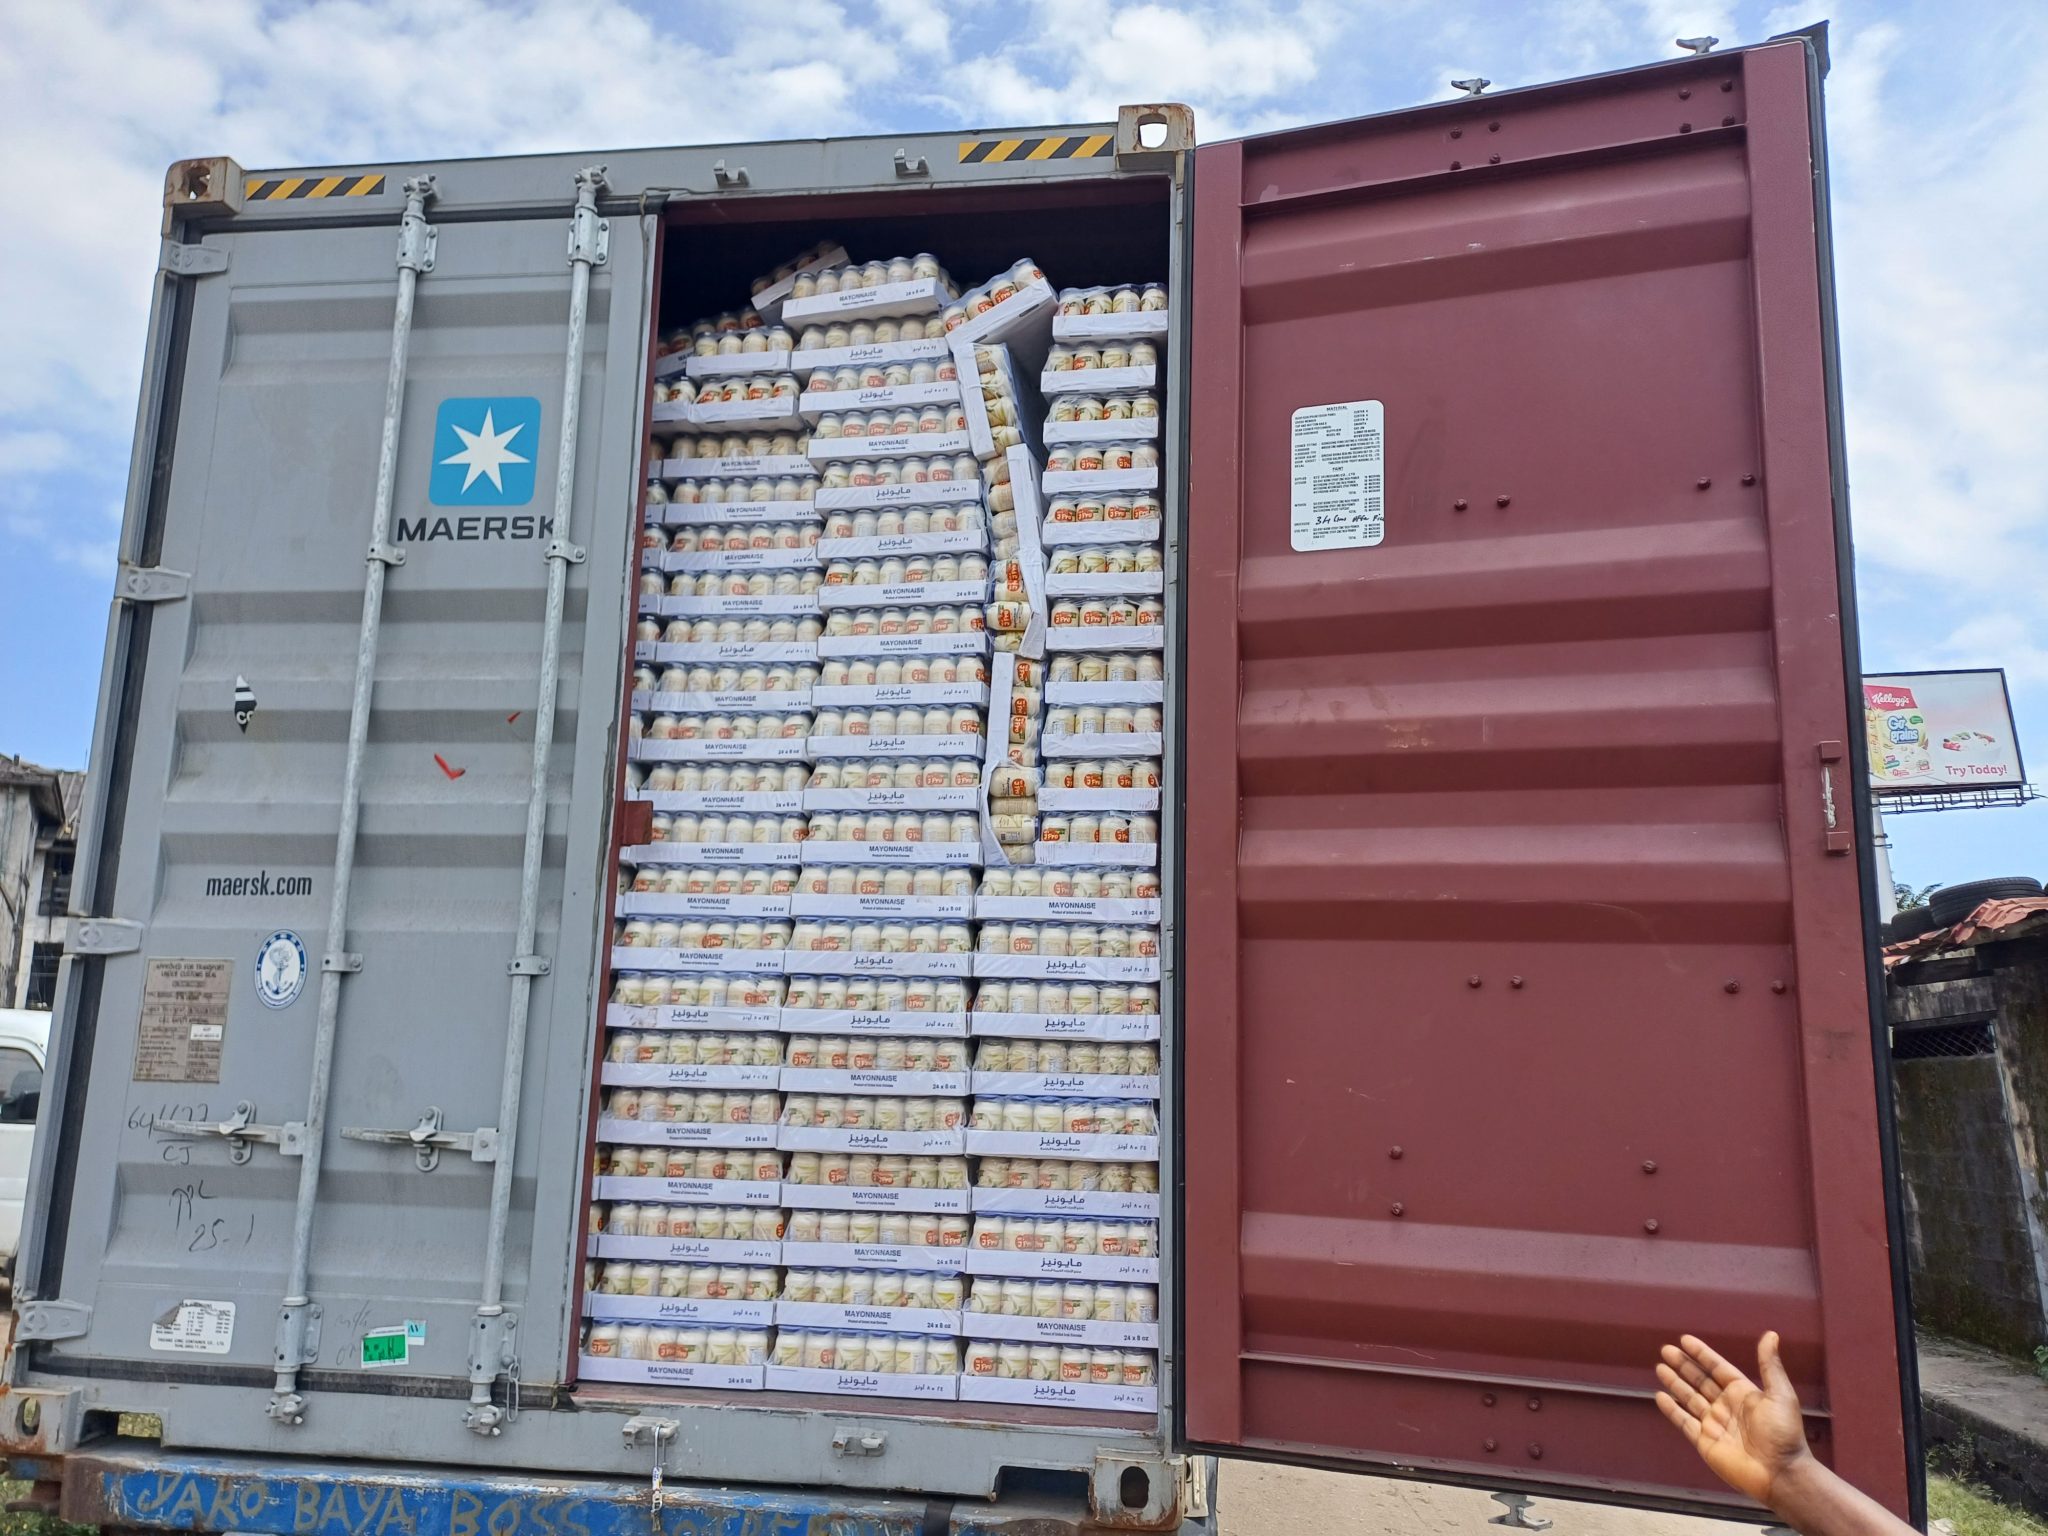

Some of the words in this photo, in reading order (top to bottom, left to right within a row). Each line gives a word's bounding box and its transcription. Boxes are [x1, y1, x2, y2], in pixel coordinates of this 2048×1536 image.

[839, 291, 877, 302] MAYONNAISE
[869, 439, 909, 447] MAYONNAISE
[876, 488, 911, 497] مايونيز
[397, 516, 554, 542] MAERSK
[878, 538, 912, 548] مايونيز
[876, 688, 911, 697] مايونيز
[1872, 692, 1910, 706] Kellogg's
[1888, 716, 1906, 730] Go
[1890, 730, 1919, 744] grains
[869, 738, 905, 748] مايونيز
[1945, 766, 1966, 777] Try
[1968, 765, 2008, 776] Today!
[867, 791, 904, 801] مايونيز
[206, 870, 312, 896] maersk.com
[854, 956, 893, 966] مايونيز
[1046, 960, 1086, 970] مايونيز
[850, 1015, 890, 1024] مايونيز
[1045, 1018, 1085, 1028] مايونيز
[1044, 1078, 1084, 1087] مايونيز
[848, 1134, 888, 1143] مايونيز
[1040, 1137, 1080, 1146] مايونيز
[668, 1182, 713, 1190] MAYONNAISE
[852, 1192, 899, 1200] MAYONNAISE
[1044, 1194, 1085, 1204] مايونيز
[1041, 1257, 1082, 1267] مايونيز
[844, 1310, 891, 1319] MAYONNAISE
[1037, 1322, 1086, 1331] MAYONNAISE
[648, 1366, 694, 1375] MAYONNAISE
[837, 1376, 878, 1385] مايونيز
[1034, 1386, 1076, 1395] مايونيز
[294, 1483, 415, 1536] BAYA
[451, 1490, 590, 1536] BOSS
